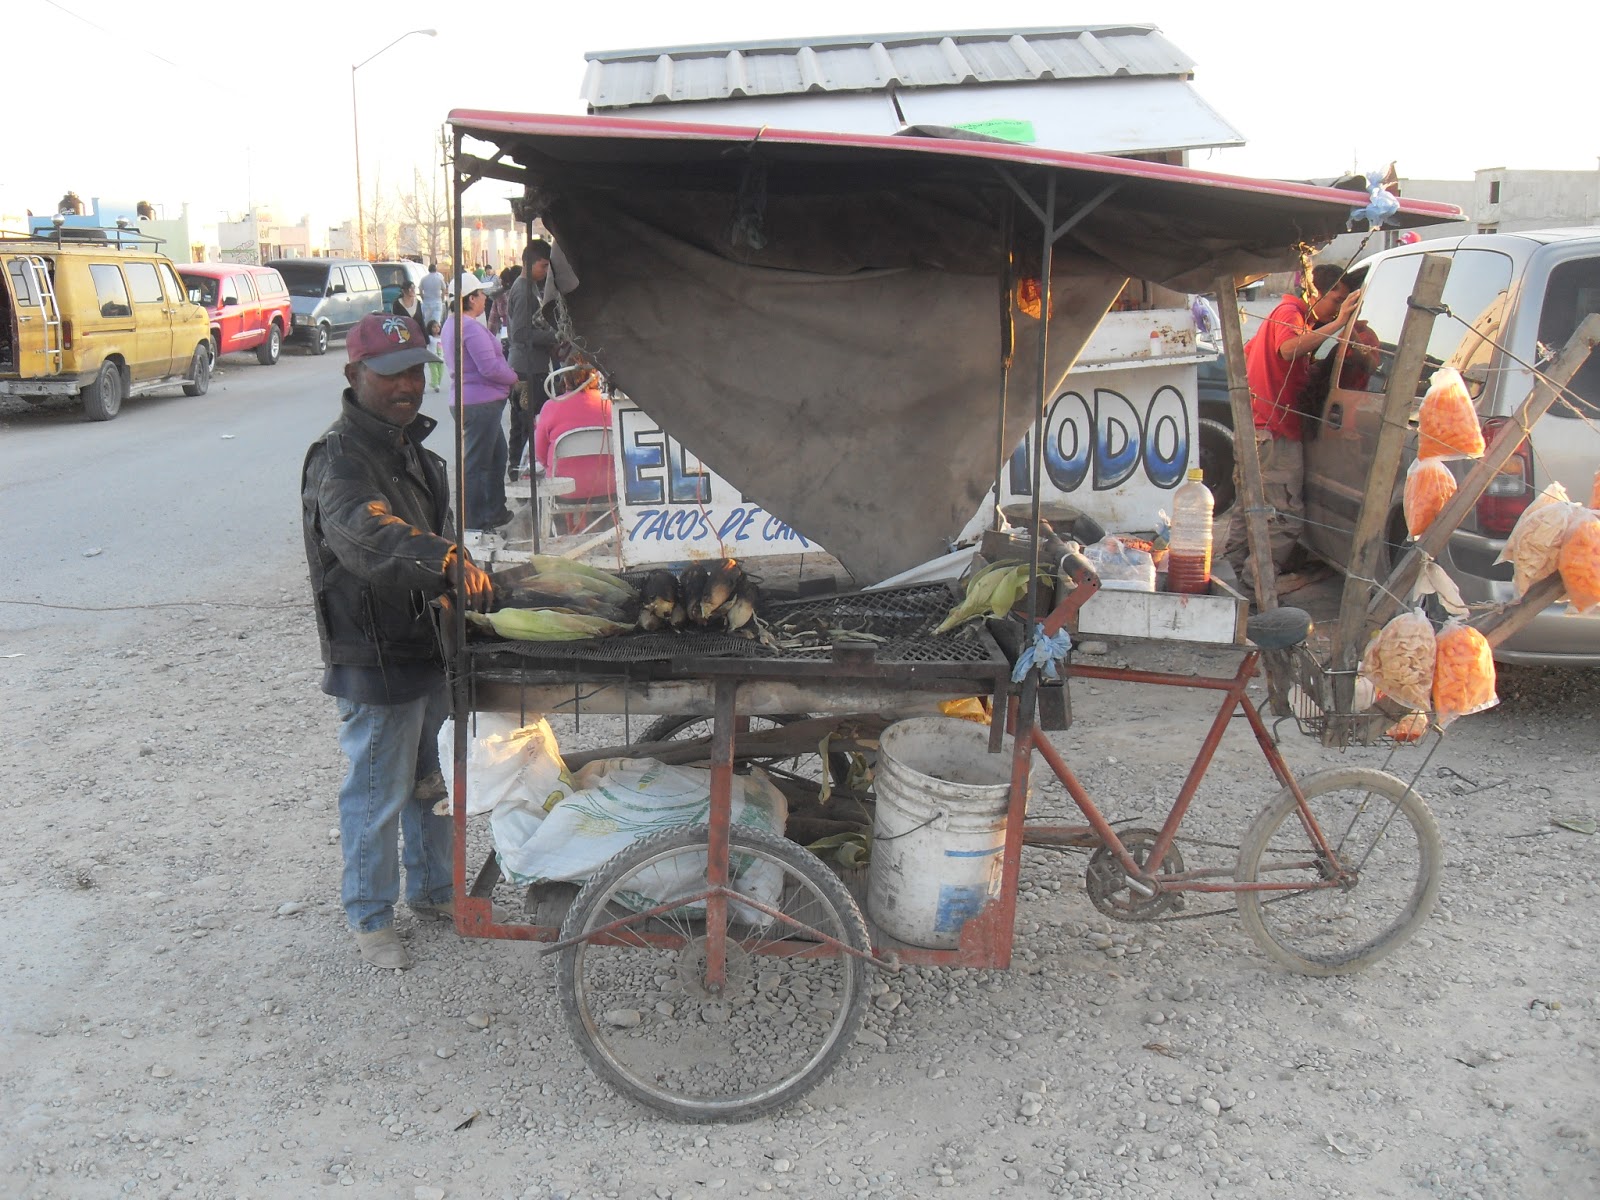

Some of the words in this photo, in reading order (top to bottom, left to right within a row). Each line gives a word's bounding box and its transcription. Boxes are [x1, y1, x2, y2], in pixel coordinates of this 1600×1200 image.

[619, 408, 712, 506] EL
[629, 509, 712, 541] TACOS
[717, 508, 762, 541] DE
